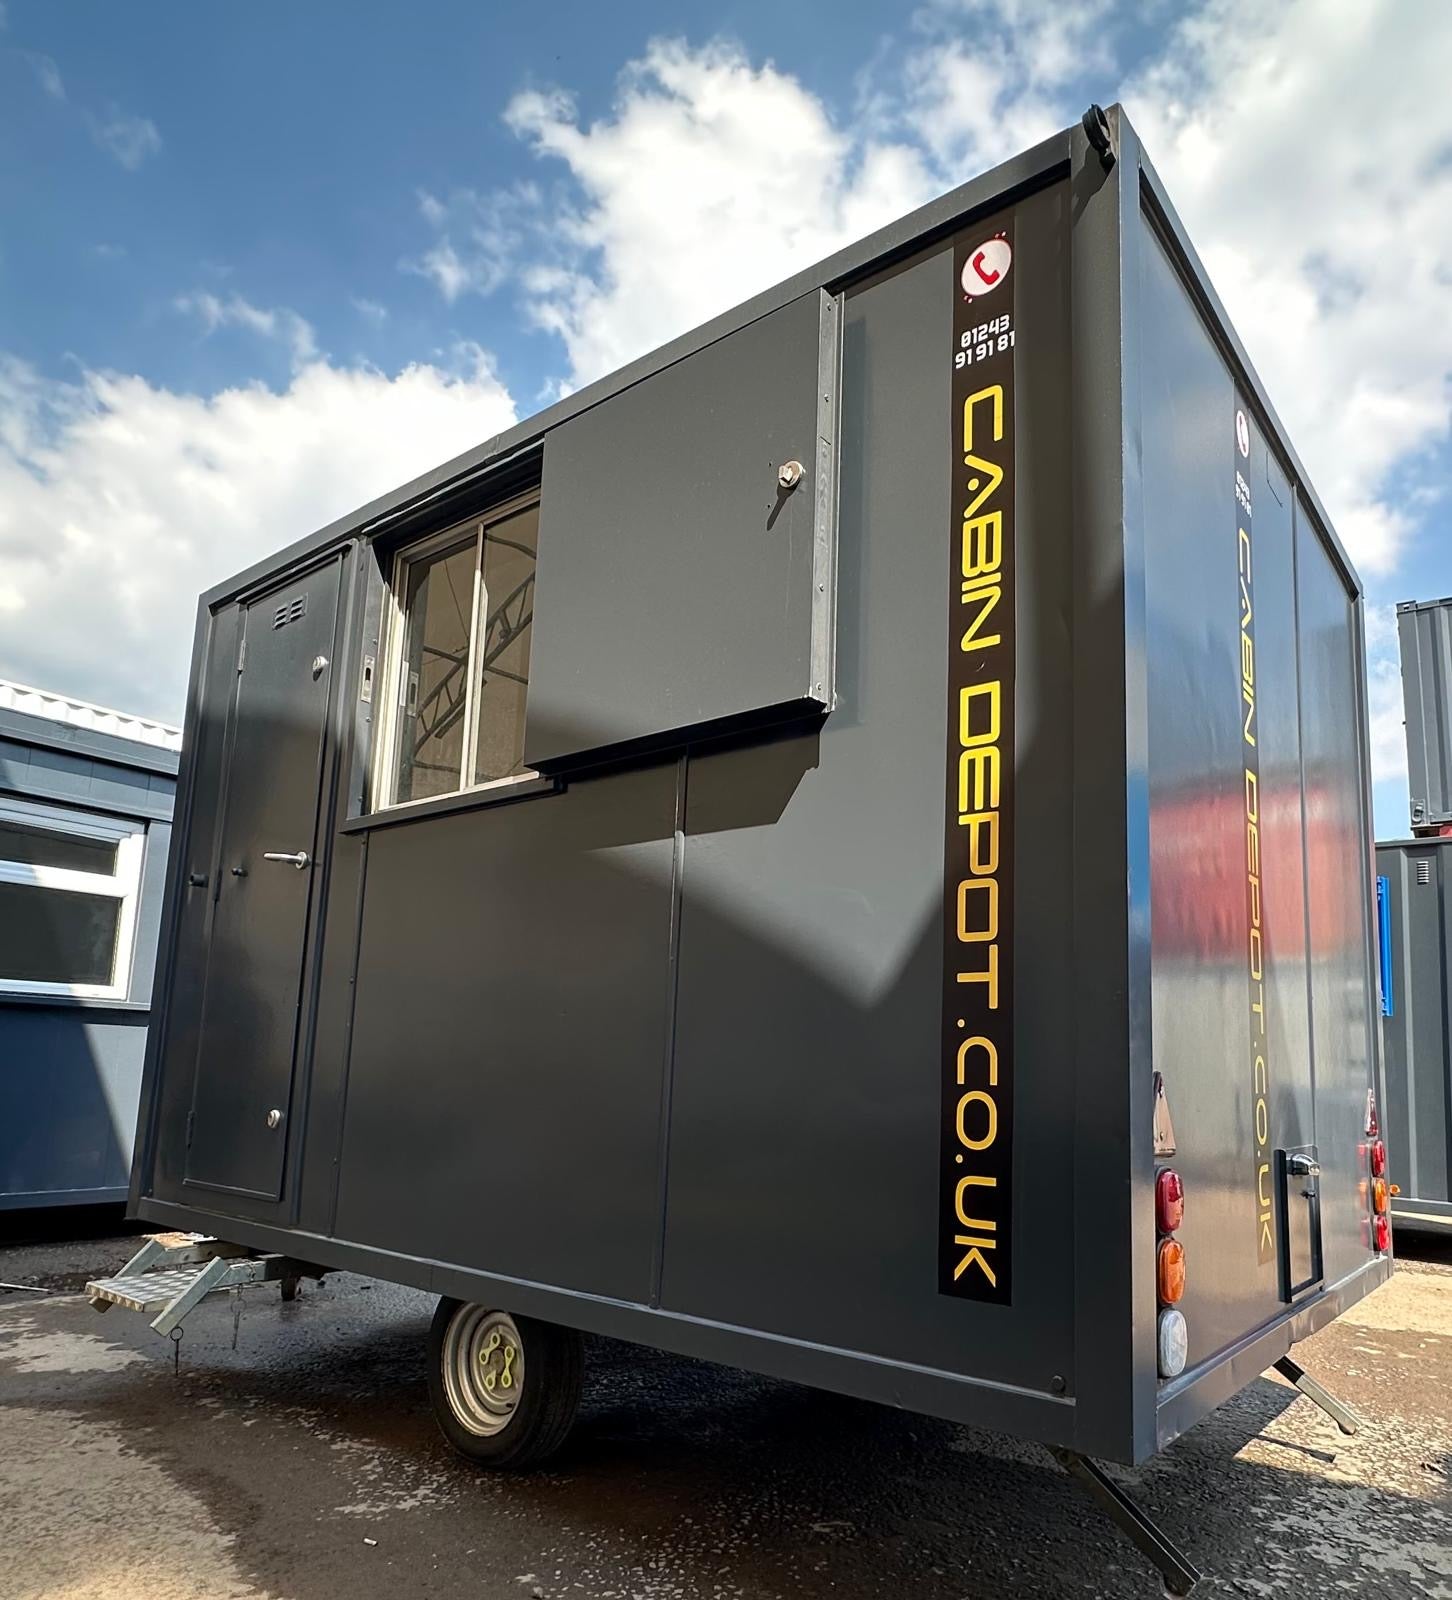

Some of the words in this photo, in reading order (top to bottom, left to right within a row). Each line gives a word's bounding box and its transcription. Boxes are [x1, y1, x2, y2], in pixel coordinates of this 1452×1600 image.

[955, 349, 972, 369] 91
[976, 340, 993, 361] 91
[997, 331, 1015, 351] 81
[961, 314, 1010, 348] 01243
[961, 385, 1003, 652] CABIN
[1239, 528, 1255, 746] CABIN
